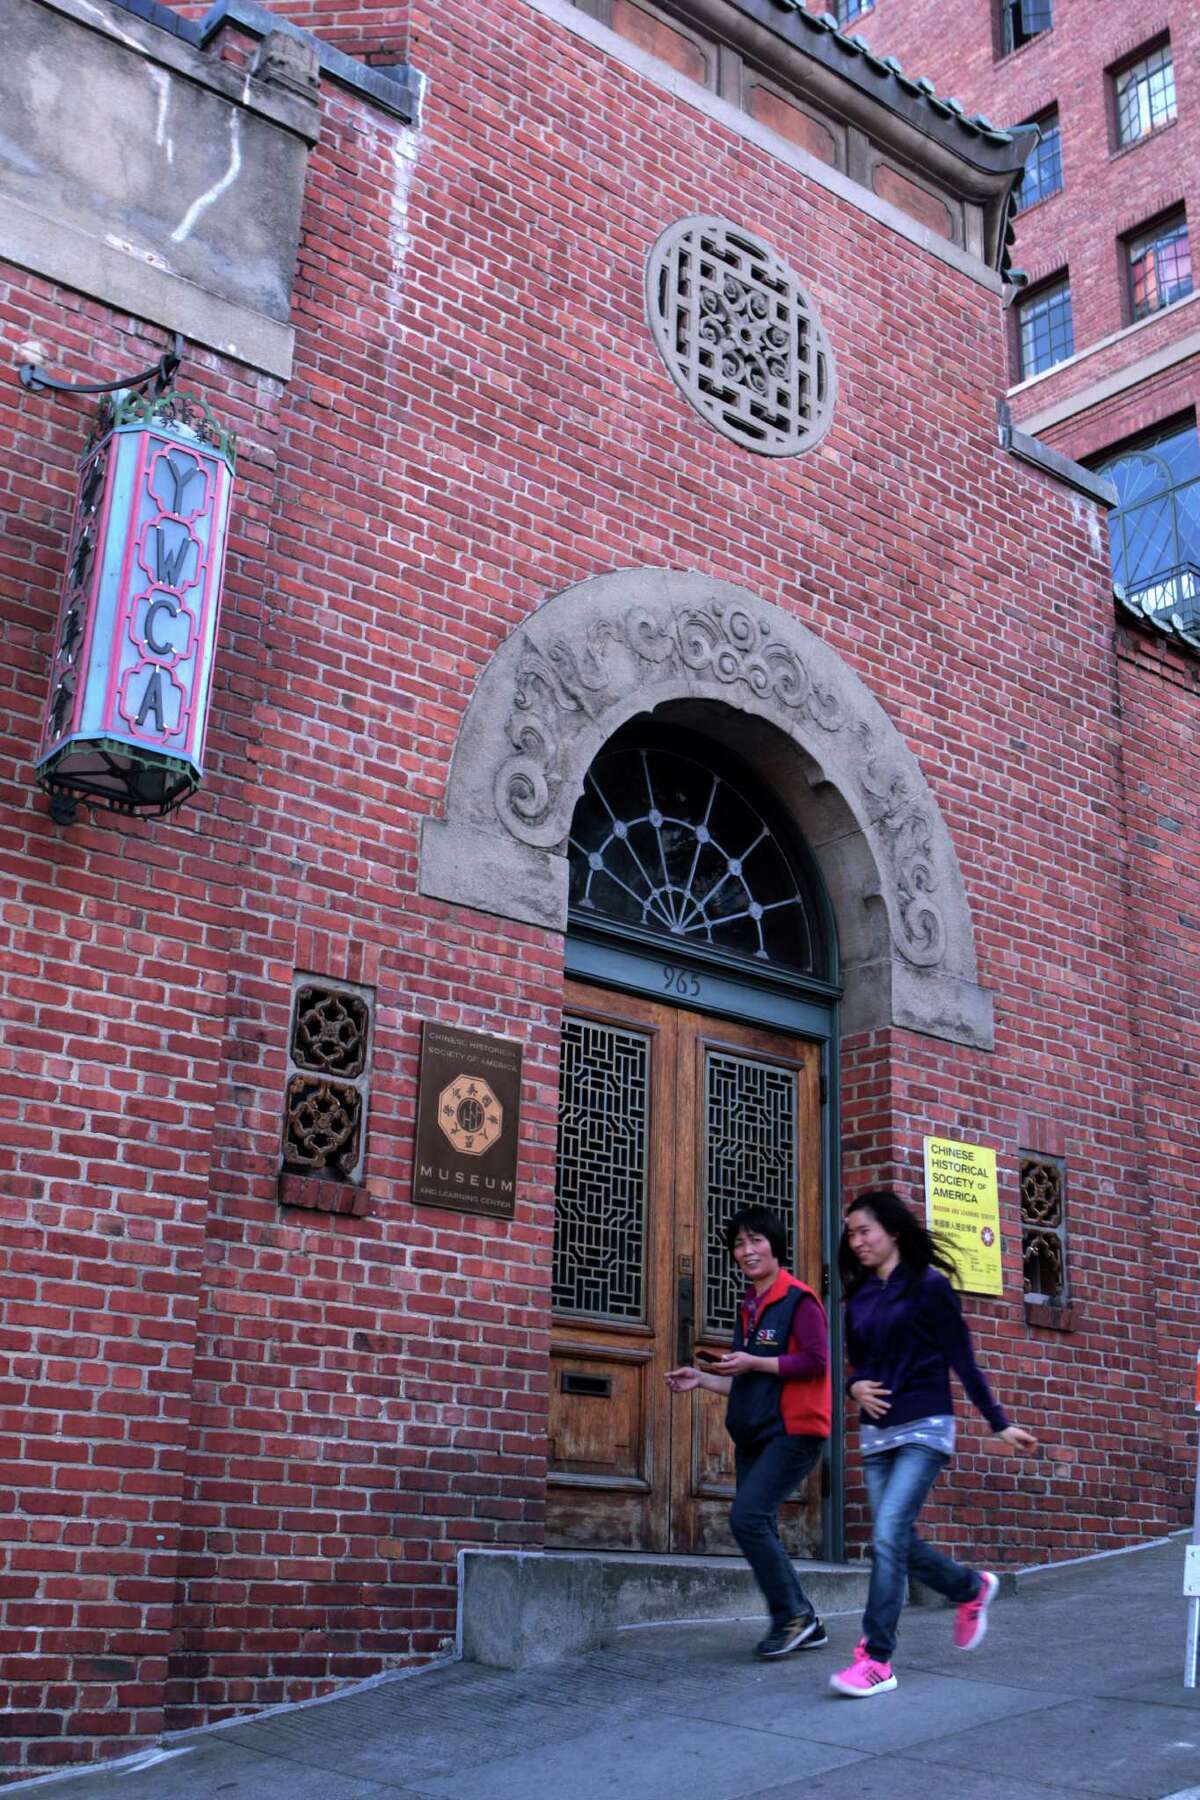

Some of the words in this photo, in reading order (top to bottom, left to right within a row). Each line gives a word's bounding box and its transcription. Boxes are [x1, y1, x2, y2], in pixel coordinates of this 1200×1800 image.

[137, 455, 200, 732] YWCA
[663, 966, 701, 997] 965
[428, 1047, 465, 1061] SOCIETY
[931, 1144, 975, 1162] CHINESE
[931, 1158, 989, 1178] HISTORICAL
[420, 1164, 513, 1193] MUSEUM
[932, 1172, 974, 1190] SOCIETY
[977, 1183, 988, 1191] OF
[933, 1186, 978, 1204] AMERICA
